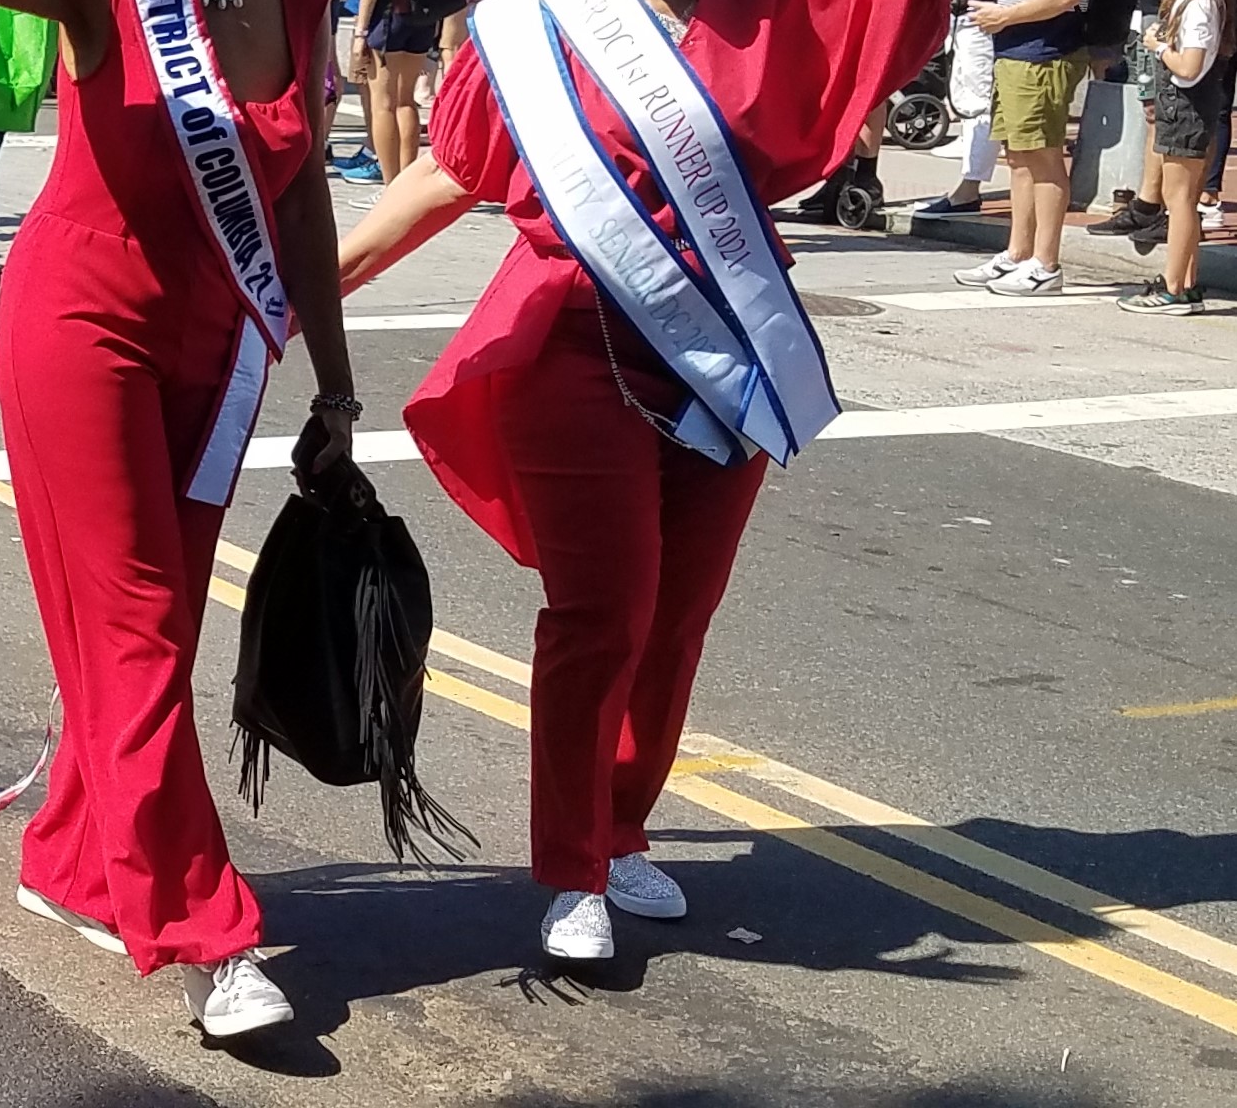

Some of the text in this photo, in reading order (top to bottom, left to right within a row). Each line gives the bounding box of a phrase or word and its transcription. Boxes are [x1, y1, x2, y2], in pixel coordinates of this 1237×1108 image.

[592, 16, 635, 54] DC
[638, 84, 713, 191] RUNNER
[194, 147, 263, 274] COLUMBIA
[692, 179, 728, 219] UP
[708, 211, 752, 271] 2021
